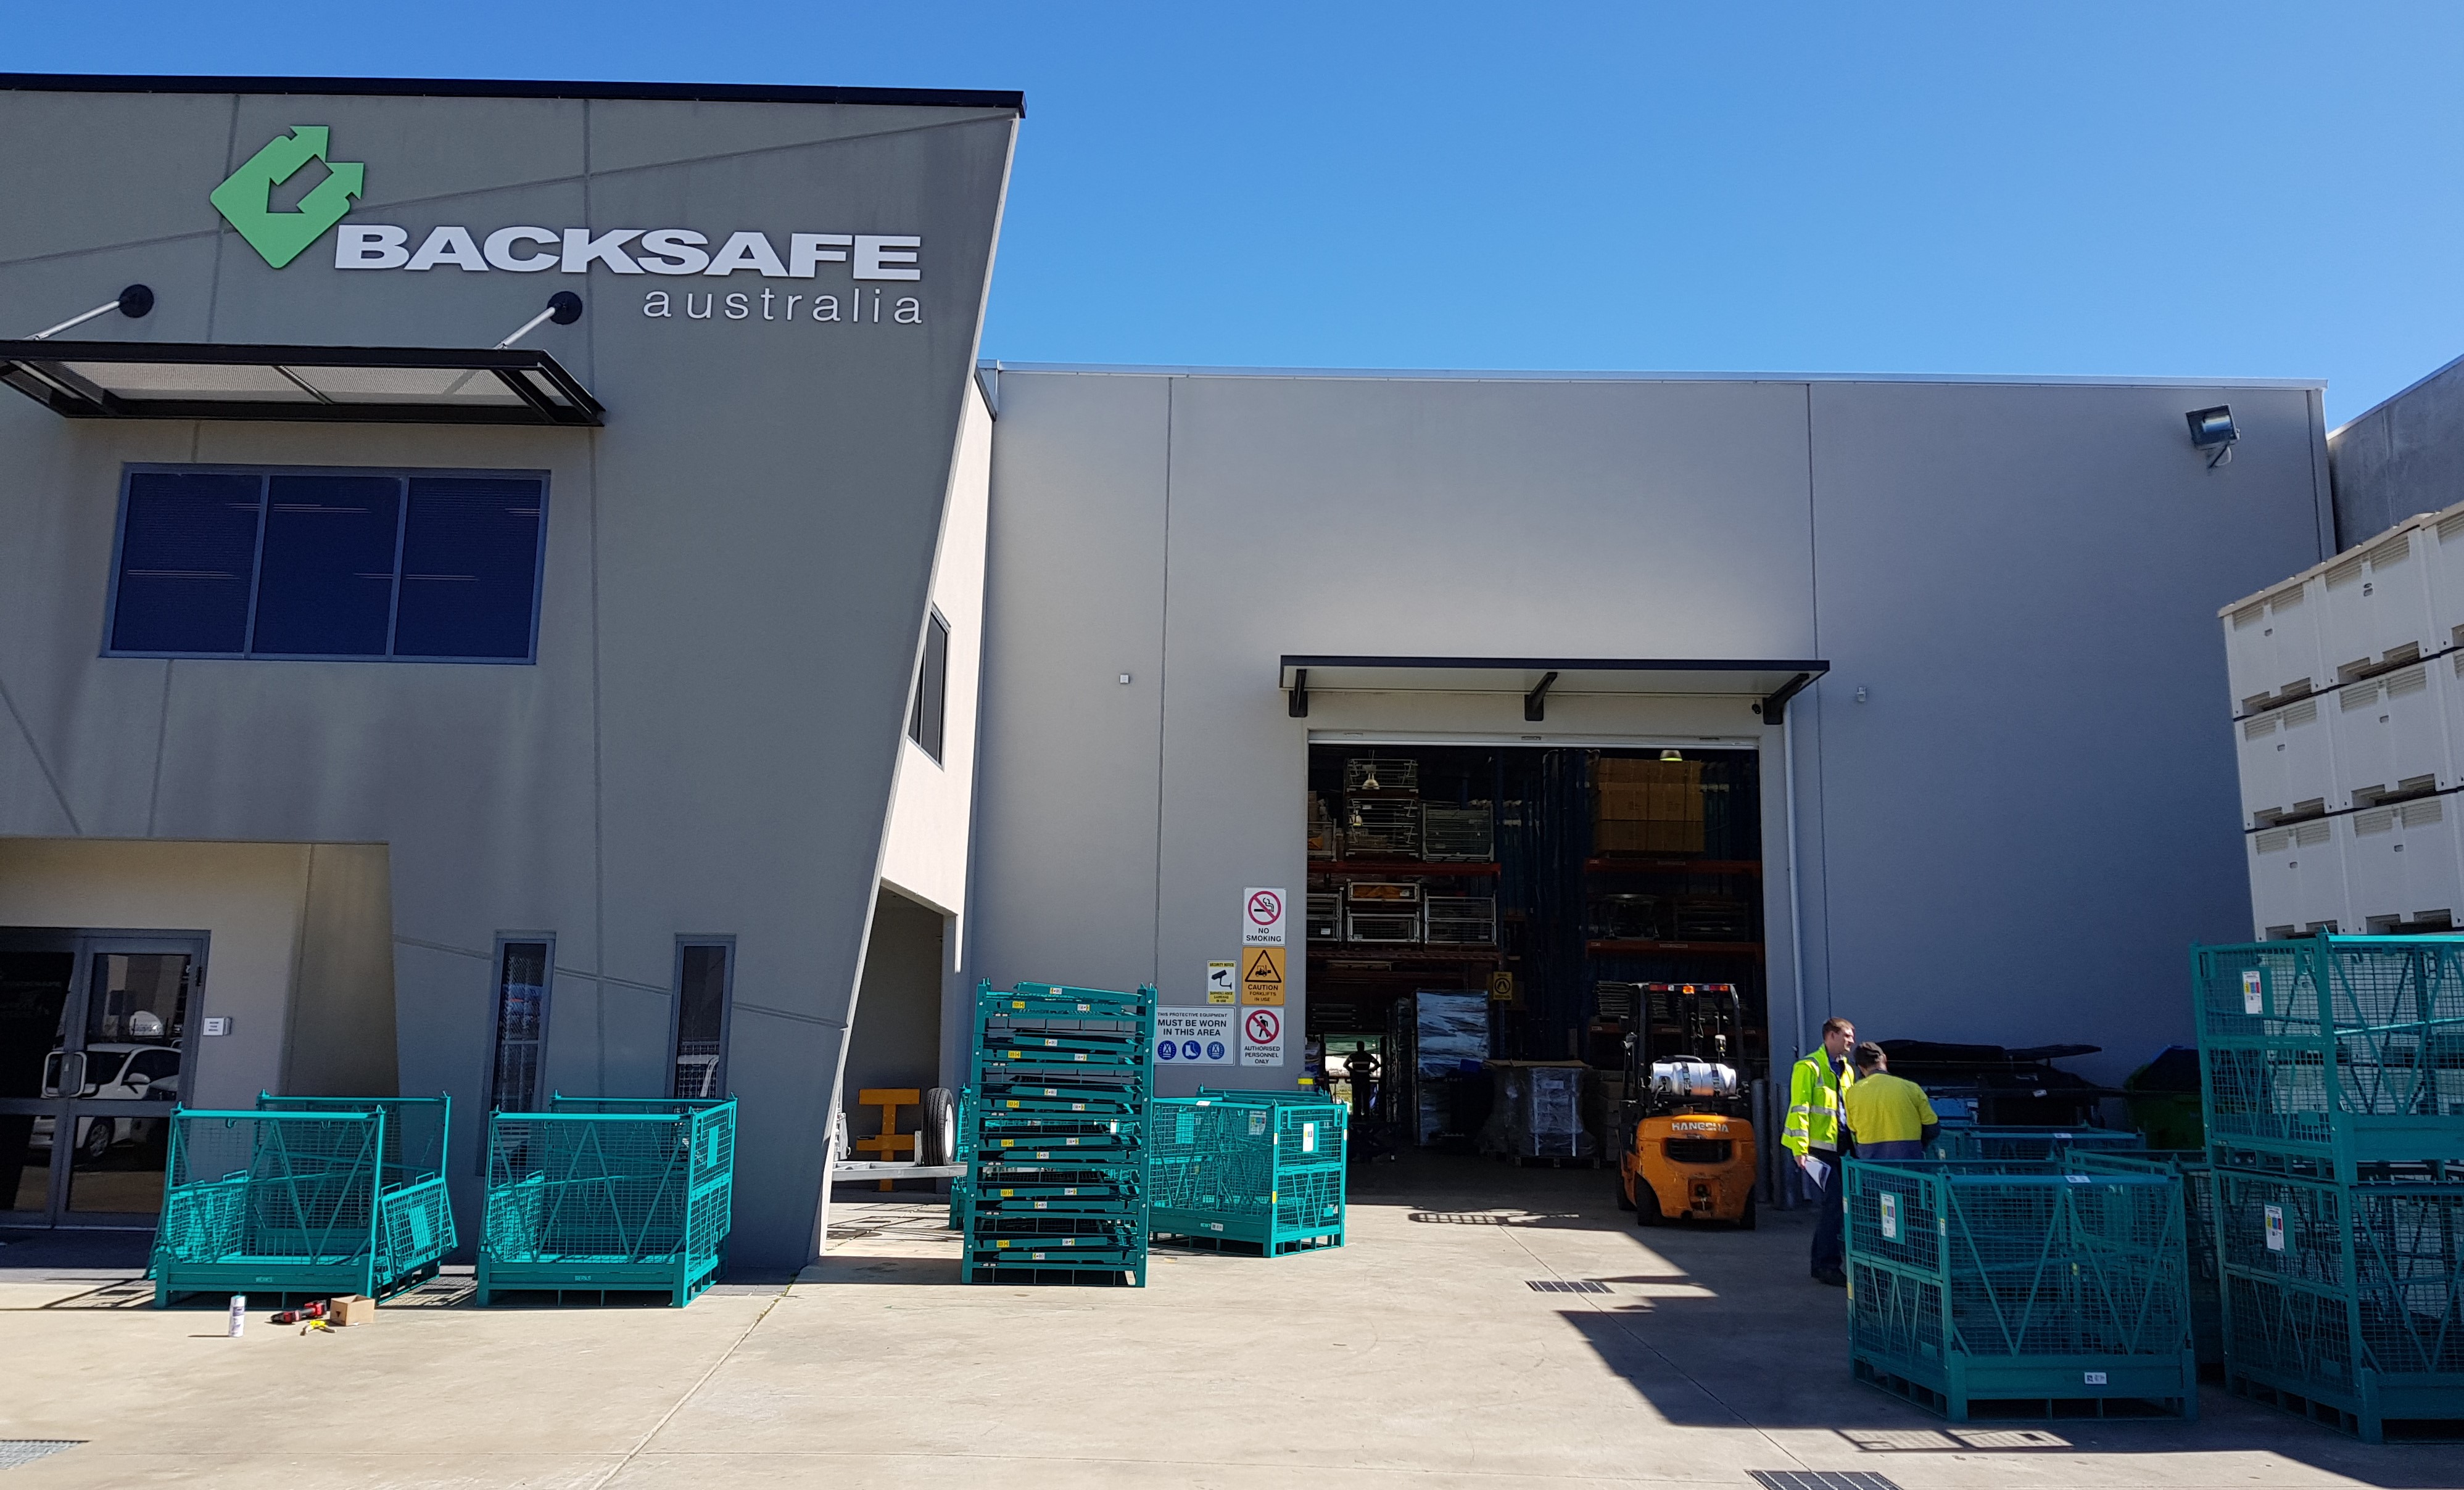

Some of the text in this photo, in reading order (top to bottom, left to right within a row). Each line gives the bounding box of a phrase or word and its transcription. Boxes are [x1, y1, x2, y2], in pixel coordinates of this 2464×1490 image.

[334, 224, 921, 281] BACKSAFE
[642, 287, 922, 324] australia
[1157, 1019, 1183, 1027] MUST
